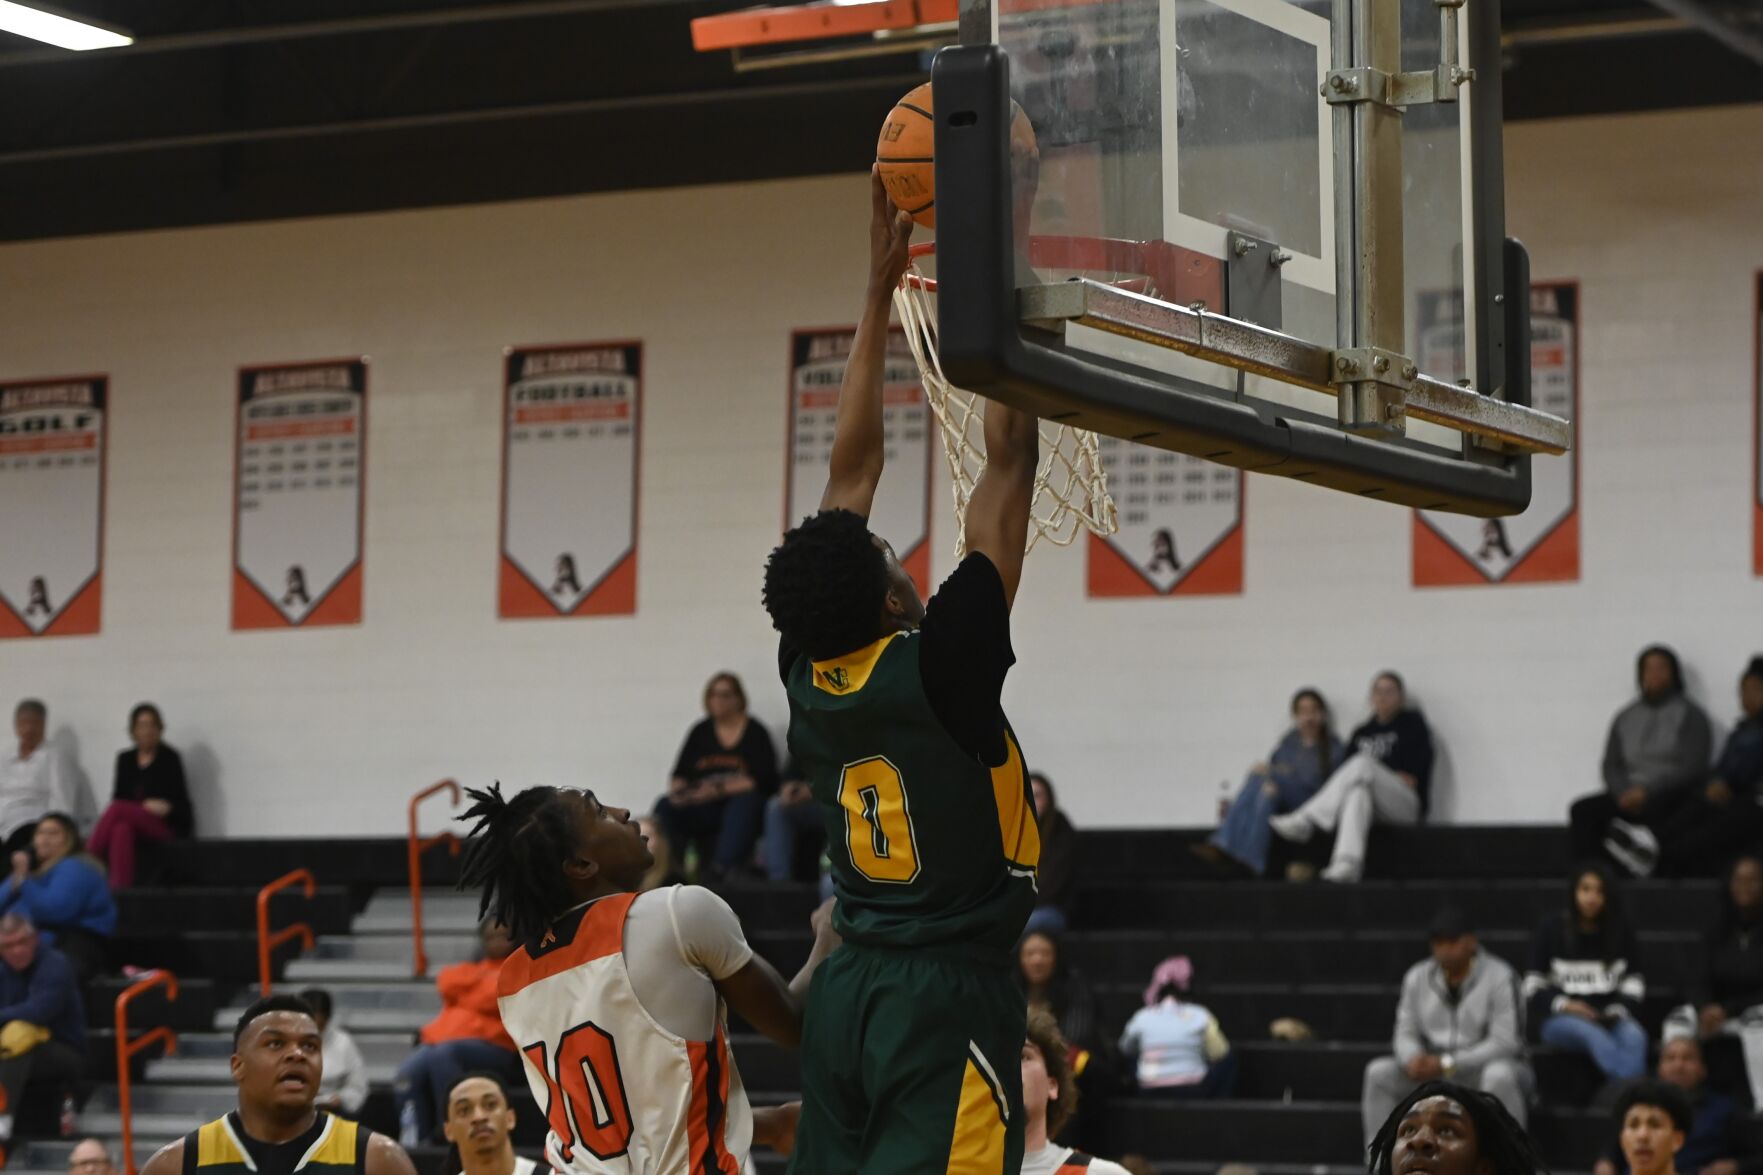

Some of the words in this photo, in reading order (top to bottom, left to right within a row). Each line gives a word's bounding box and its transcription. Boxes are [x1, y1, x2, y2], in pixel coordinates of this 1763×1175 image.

[516, 380, 626, 402] FOOTBALL
[0, 413, 93, 435] GOLF
[1149, 526, 1180, 572] A
[1477, 518, 1511, 561] A
[282, 564, 310, 606] A
[552, 551, 581, 594] A
[26, 575, 51, 616] A
[837, 754, 921, 885] 0
[522, 1020, 635, 1164] 10
